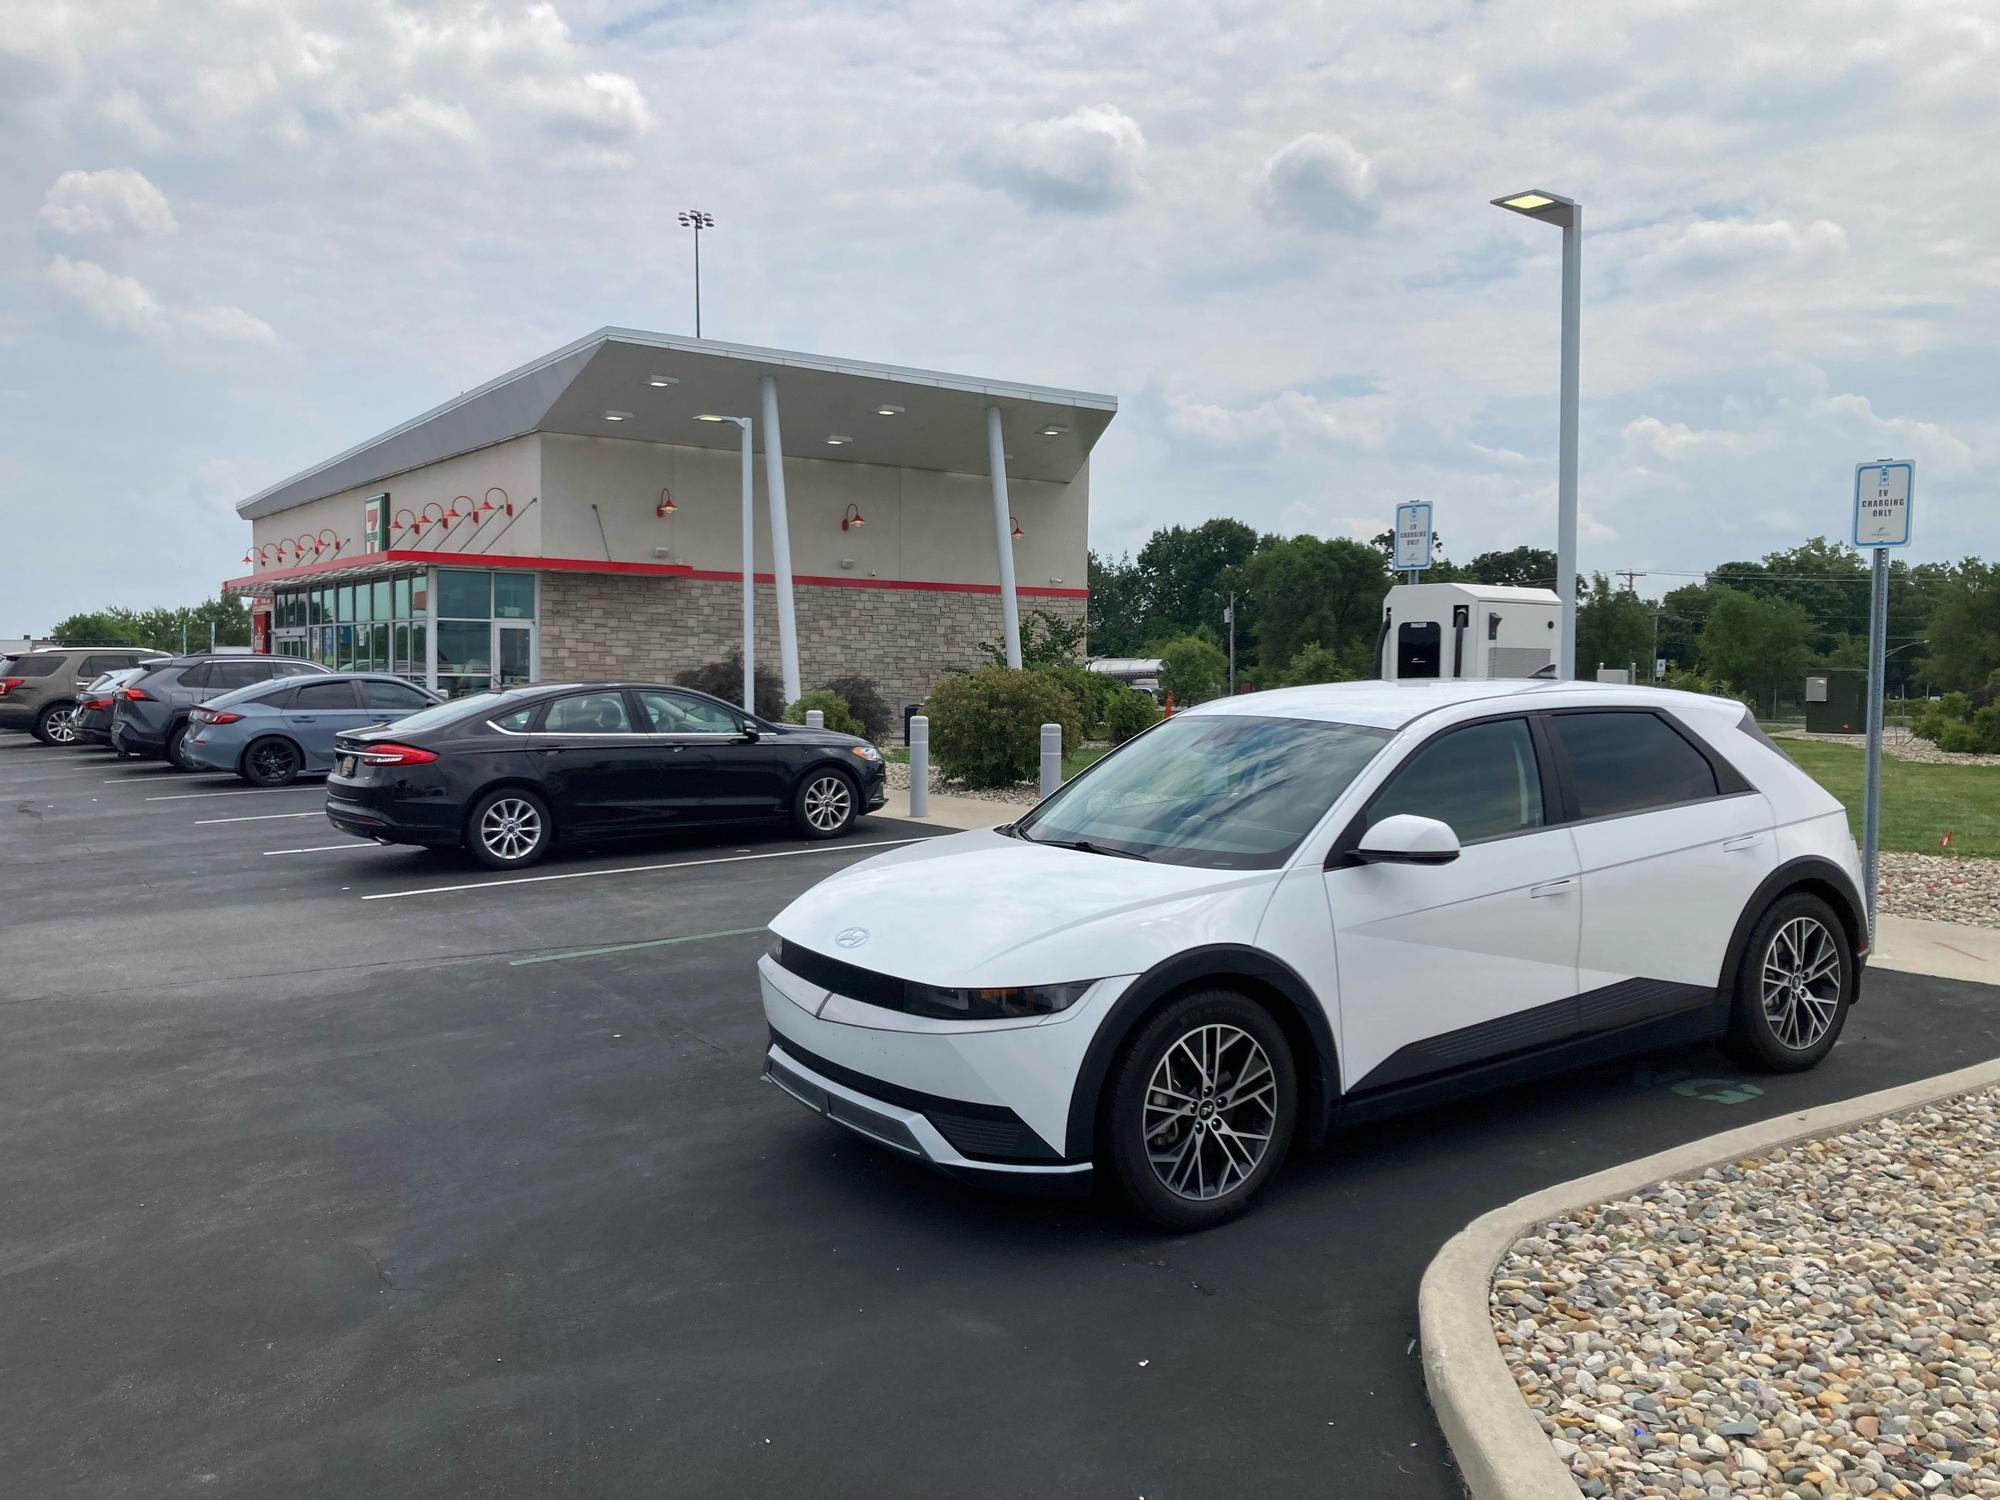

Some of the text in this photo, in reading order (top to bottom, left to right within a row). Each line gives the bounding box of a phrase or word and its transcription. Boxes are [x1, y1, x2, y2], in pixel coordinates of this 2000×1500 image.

[1878, 489, 1889, 497] EV
[1861, 498, 1905, 508] CHARGING
[1872, 508, 1893, 517] ONLY
